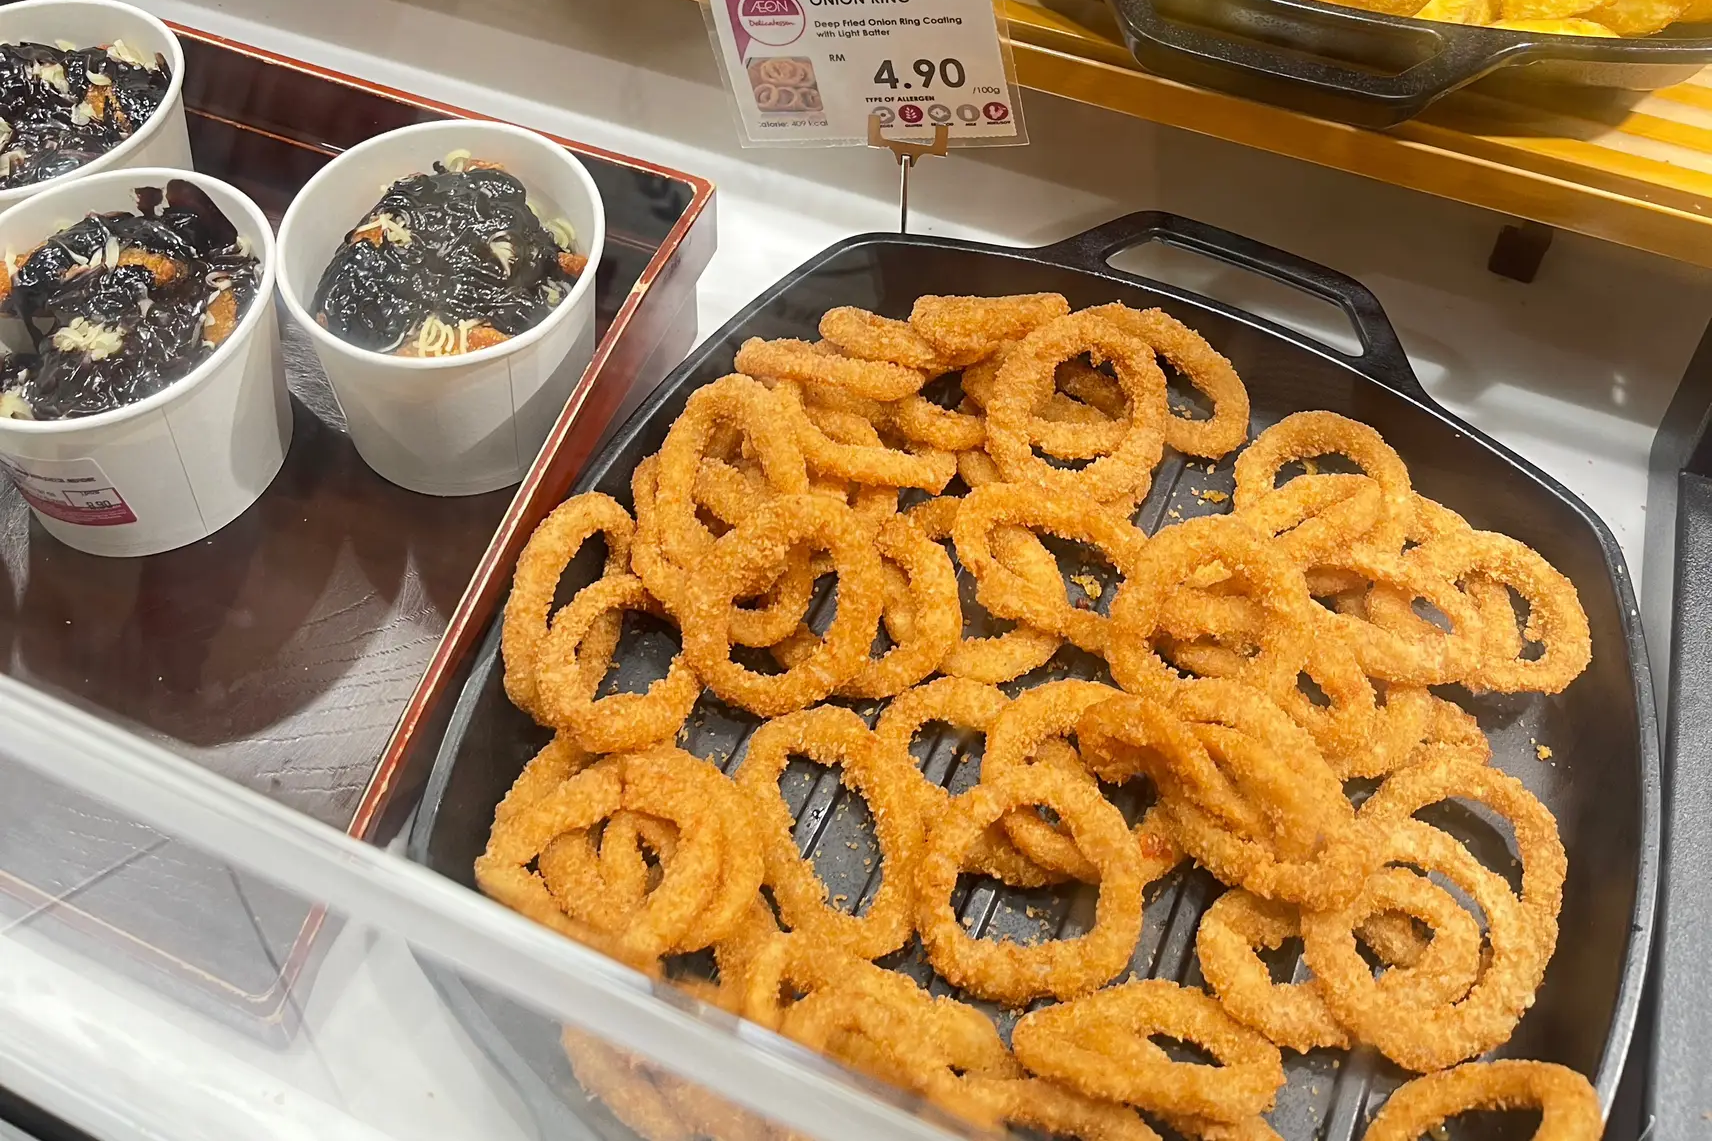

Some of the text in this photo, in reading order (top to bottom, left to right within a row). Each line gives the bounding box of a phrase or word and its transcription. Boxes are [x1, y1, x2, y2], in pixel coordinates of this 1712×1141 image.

[814, 15, 962, 30] Deep Fried Onion Ring Coating
[816, 28, 890, 39] with Light Batter
[829, 54, 966, 89] RM 4.90
[972, 85, 1001, 95] /100g
[897, 95, 935, 103] ALLERGEN
[791, 119, 807, 127] 409
